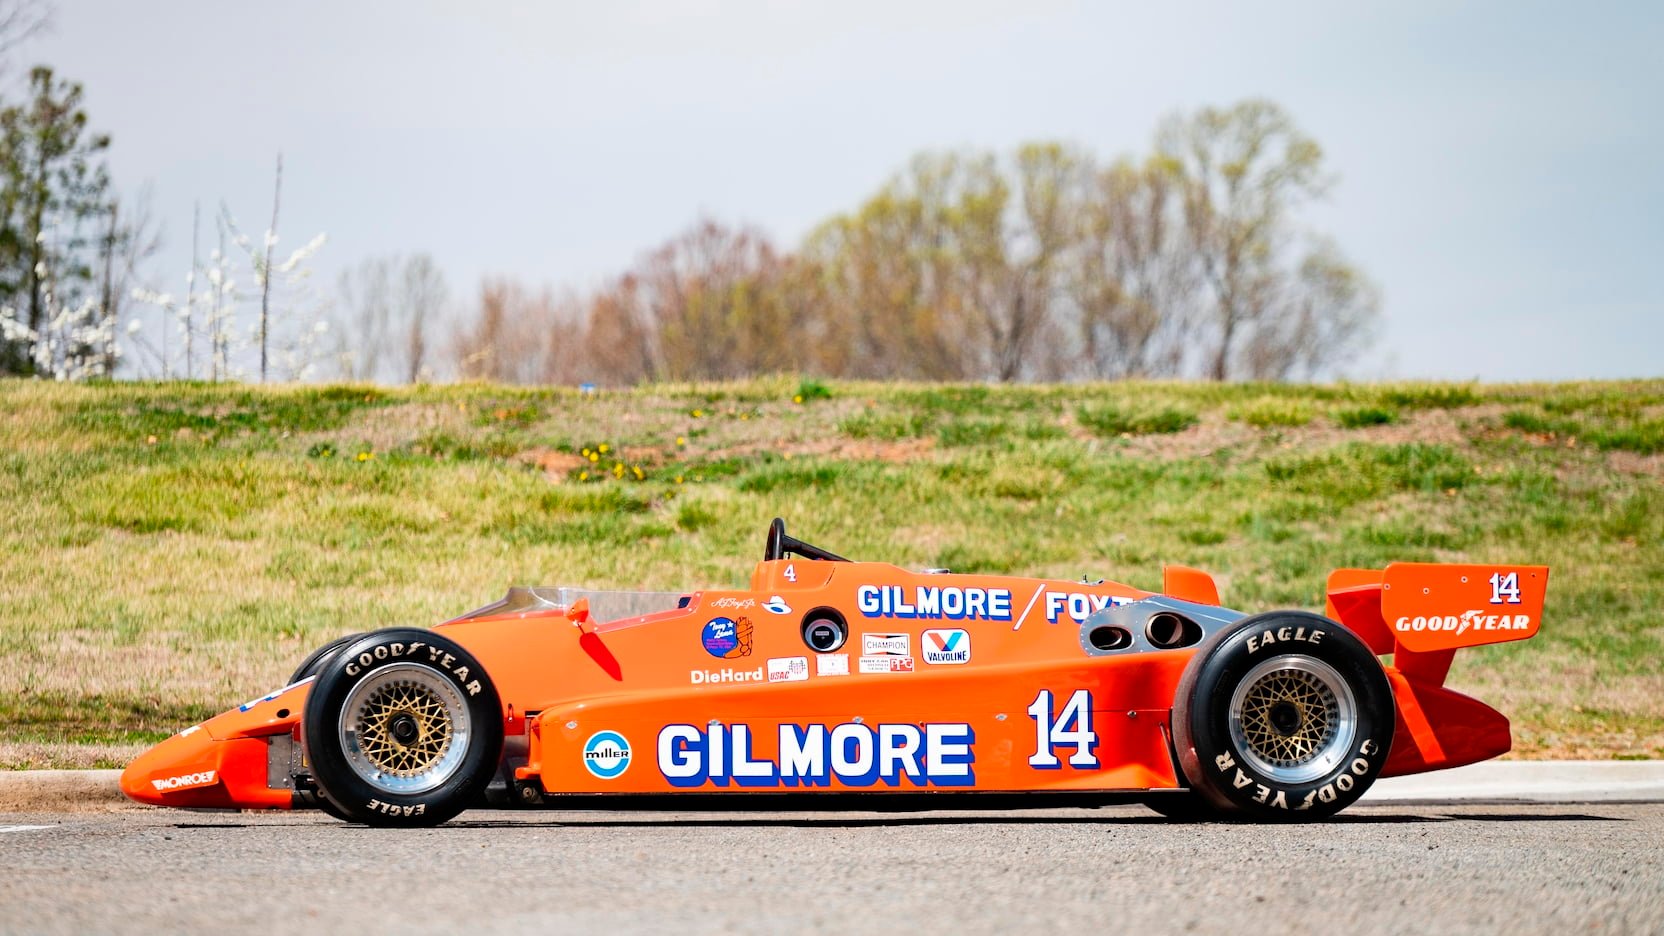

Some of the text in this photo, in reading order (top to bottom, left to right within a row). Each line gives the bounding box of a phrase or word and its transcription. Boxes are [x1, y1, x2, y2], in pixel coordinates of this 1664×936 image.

[784, 564, 797, 582] 4
[1489, 572, 1521, 604] 14
[857, 585, 1012, 621] GILMORE
[1396, 612, 1530, 634] GOODYEAR
[866, 641, 906, 649] CHAMPION
[1246, 627, 1325, 654] EAGLE
[891, 658, 913, 671] PPG
[927, 651, 967, 661] VALVOLINE
[345, 642, 482, 696] GOODYEAR
[690, 667, 763, 684] DieHard
[769, 671, 790, 681] USAC
[1027, 689, 1101, 770] 14
[657, 723, 975, 787] GILMORE
[161, 771, 209, 789] MONROE
[366, 799, 426, 817] EAGLE
